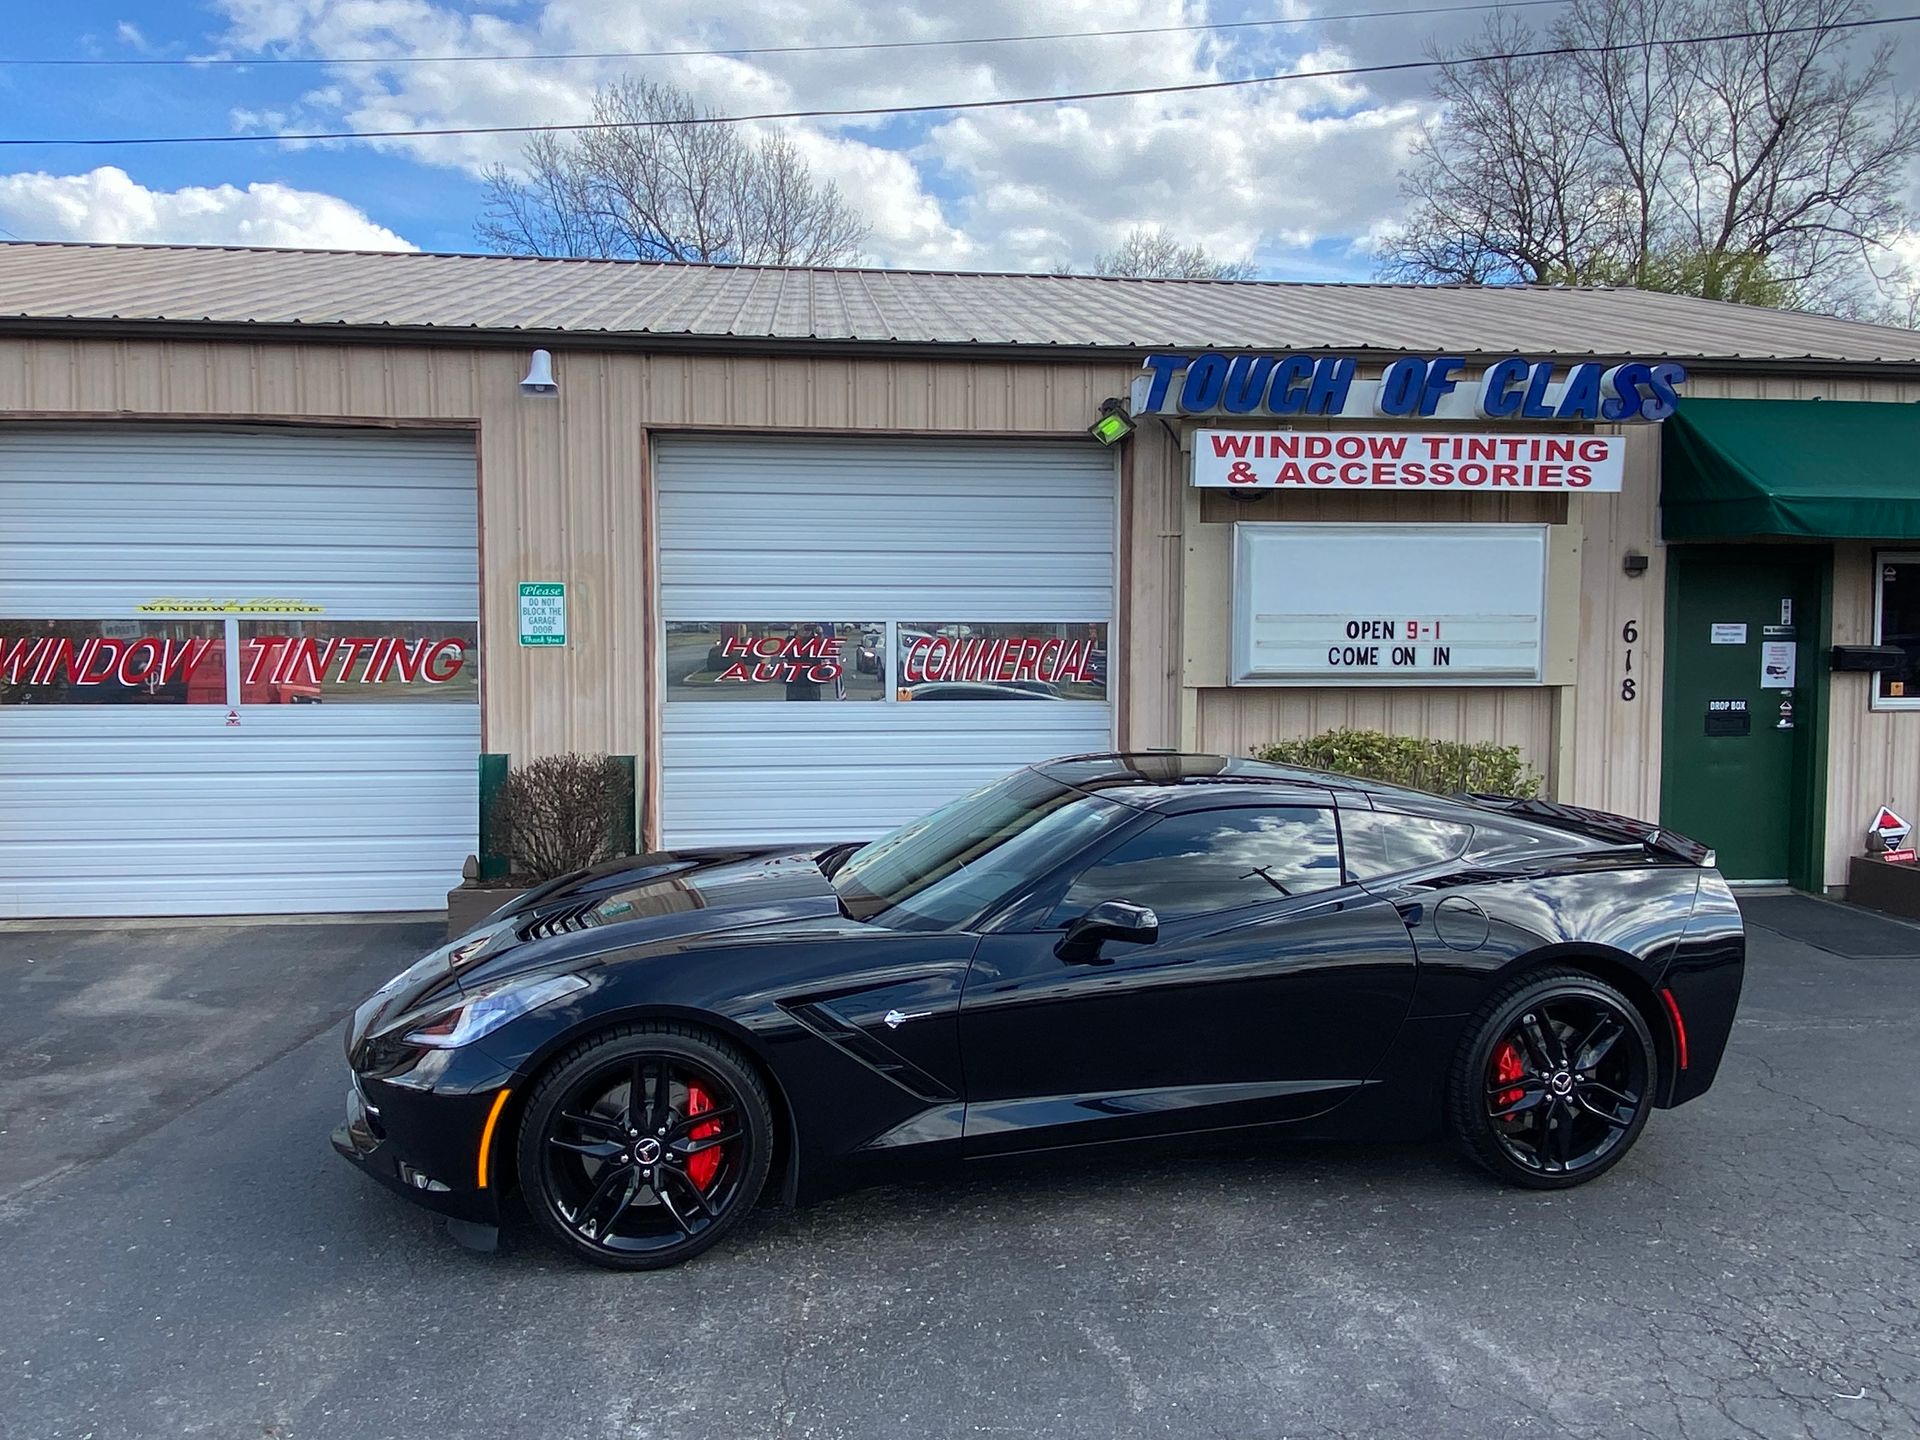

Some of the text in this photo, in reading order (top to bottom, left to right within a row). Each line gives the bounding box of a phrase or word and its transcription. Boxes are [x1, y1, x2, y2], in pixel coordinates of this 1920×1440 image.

[1143, 353, 1687, 421] TOUCH OF CLASS
[1211, 435, 1609, 462] WINDOW TINTING
[1227, 461, 1593, 488] & ACCESSORIES
[522, 585, 562, 596] Please
[522, 607, 562, 616] BLOCK THE
[529, 598, 556, 606] DO NOT
[528, 616, 557, 625] GARAGE
[532, 625, 553, 634] DOOR
[1346, 620, 1441, 640] OPEN 9-1
[546, 636, 563, 644] You!
[721, 635, 848, 658] HOME
[0, 636, 466, 686] WINDOW TINTING
[903, 636, 1096, 683] COMMERCIAL
[1328, 646, 1450, 666] COME ON IN
[714, 662, 844, 683] AUTO
[1709, 701, 1746, 711] DROP BOX
